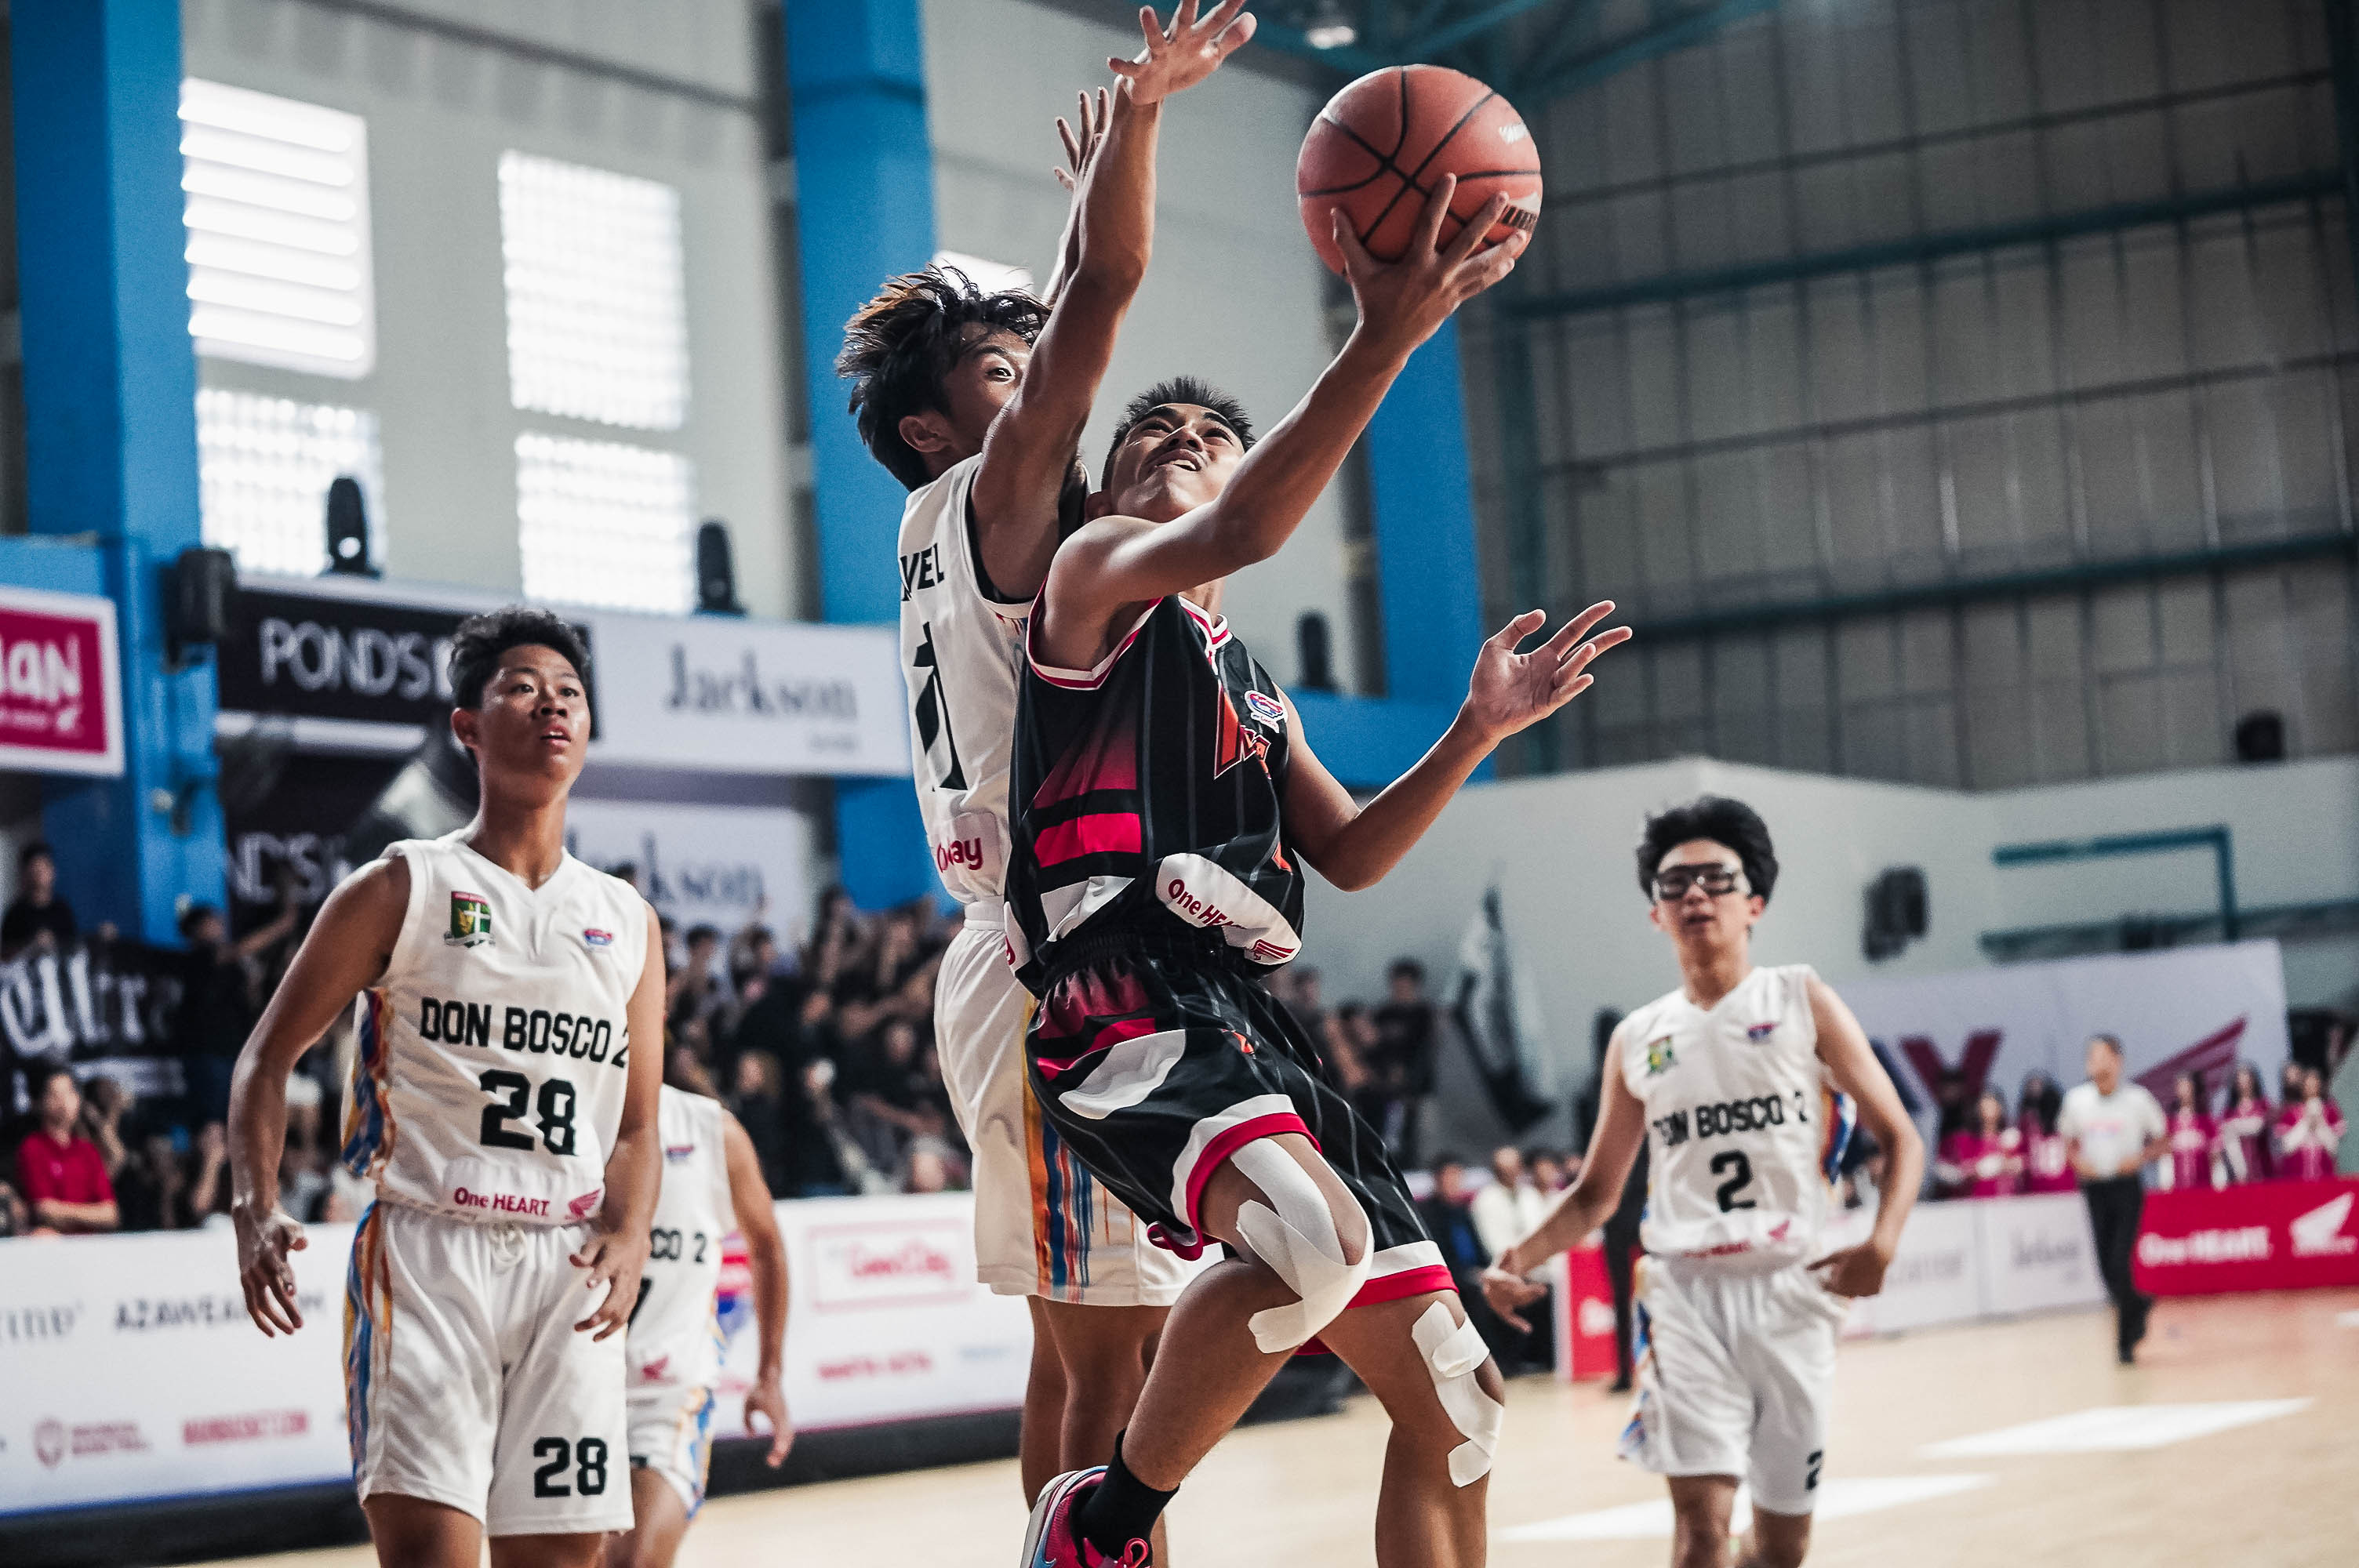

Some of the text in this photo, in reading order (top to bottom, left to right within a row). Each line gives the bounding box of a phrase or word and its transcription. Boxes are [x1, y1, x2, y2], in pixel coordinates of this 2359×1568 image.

[900, 543, 944, 601] VEL
[667, 643, 857, 717] Jackson
[1168, 879, 1201, 915] One
[420, 996, 627, 1068] DON BOSCO 2
[479, 1069, 578, 1156] 28
[1696, 1094, 1783, 1138] BOSCO
[453, 1187, 489, 1208] One
[1710, 1150, 1757, 1212] 2
[693, 1232, 707, 1263] 2
[533, 1436, 608, 1498] 28
